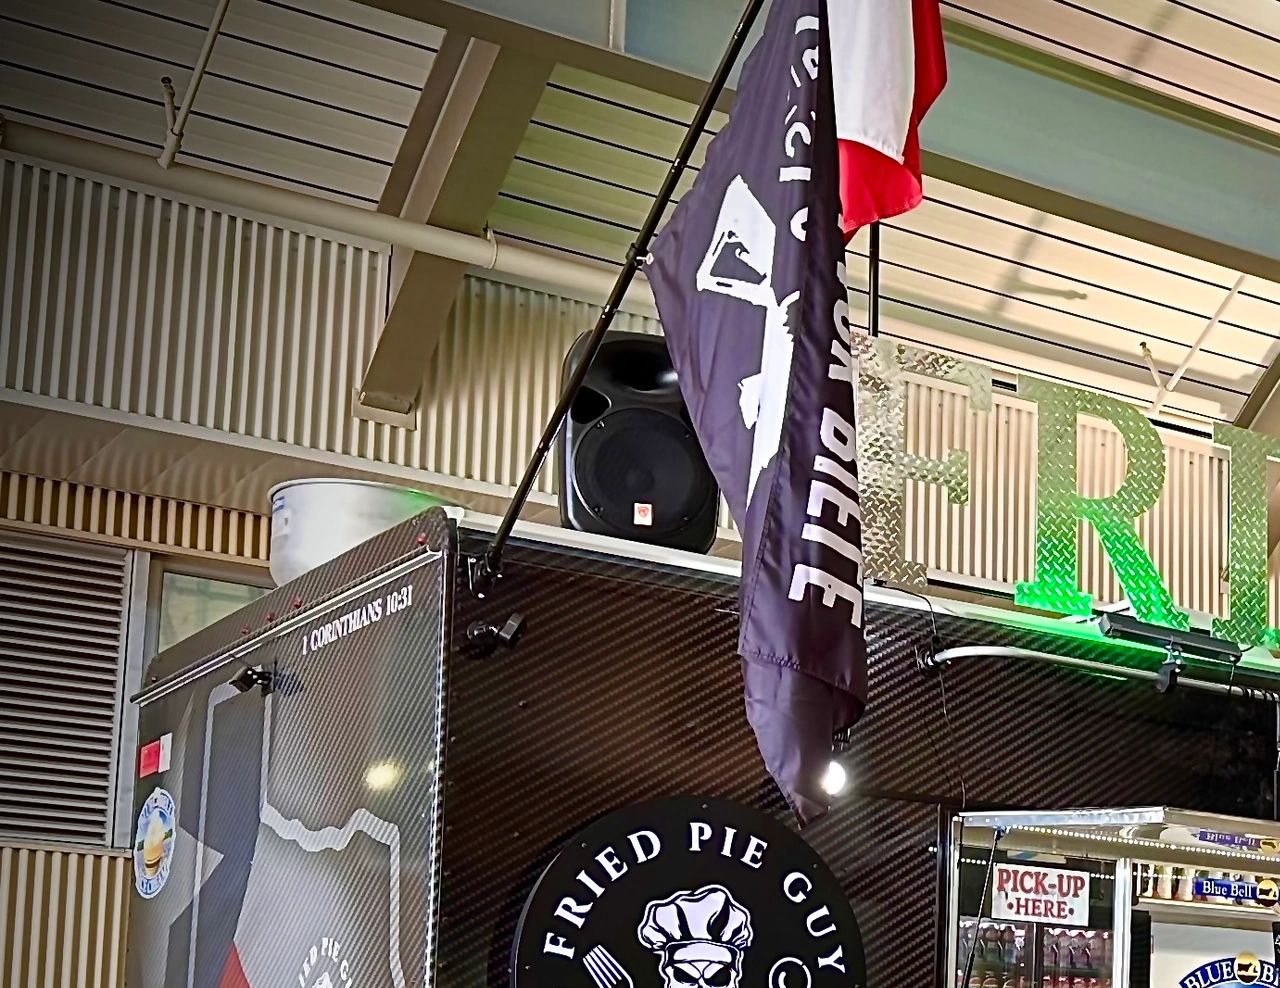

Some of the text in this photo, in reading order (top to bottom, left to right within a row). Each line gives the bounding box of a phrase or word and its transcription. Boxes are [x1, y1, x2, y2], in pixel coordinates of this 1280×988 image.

[301, 584, 413, 656] 1 CORINTHIANS 10:31
[543, 821, 847, 975] FRIED PIE GUY
[996, 868, 1086, 899] PICK-UP
[1201, 879, 1228, 897] Blue
[1230, 880, 1253, 899] Bell
[1014, 896, 1068, 921] HERE
[320, 936, 341, 963] PIE
